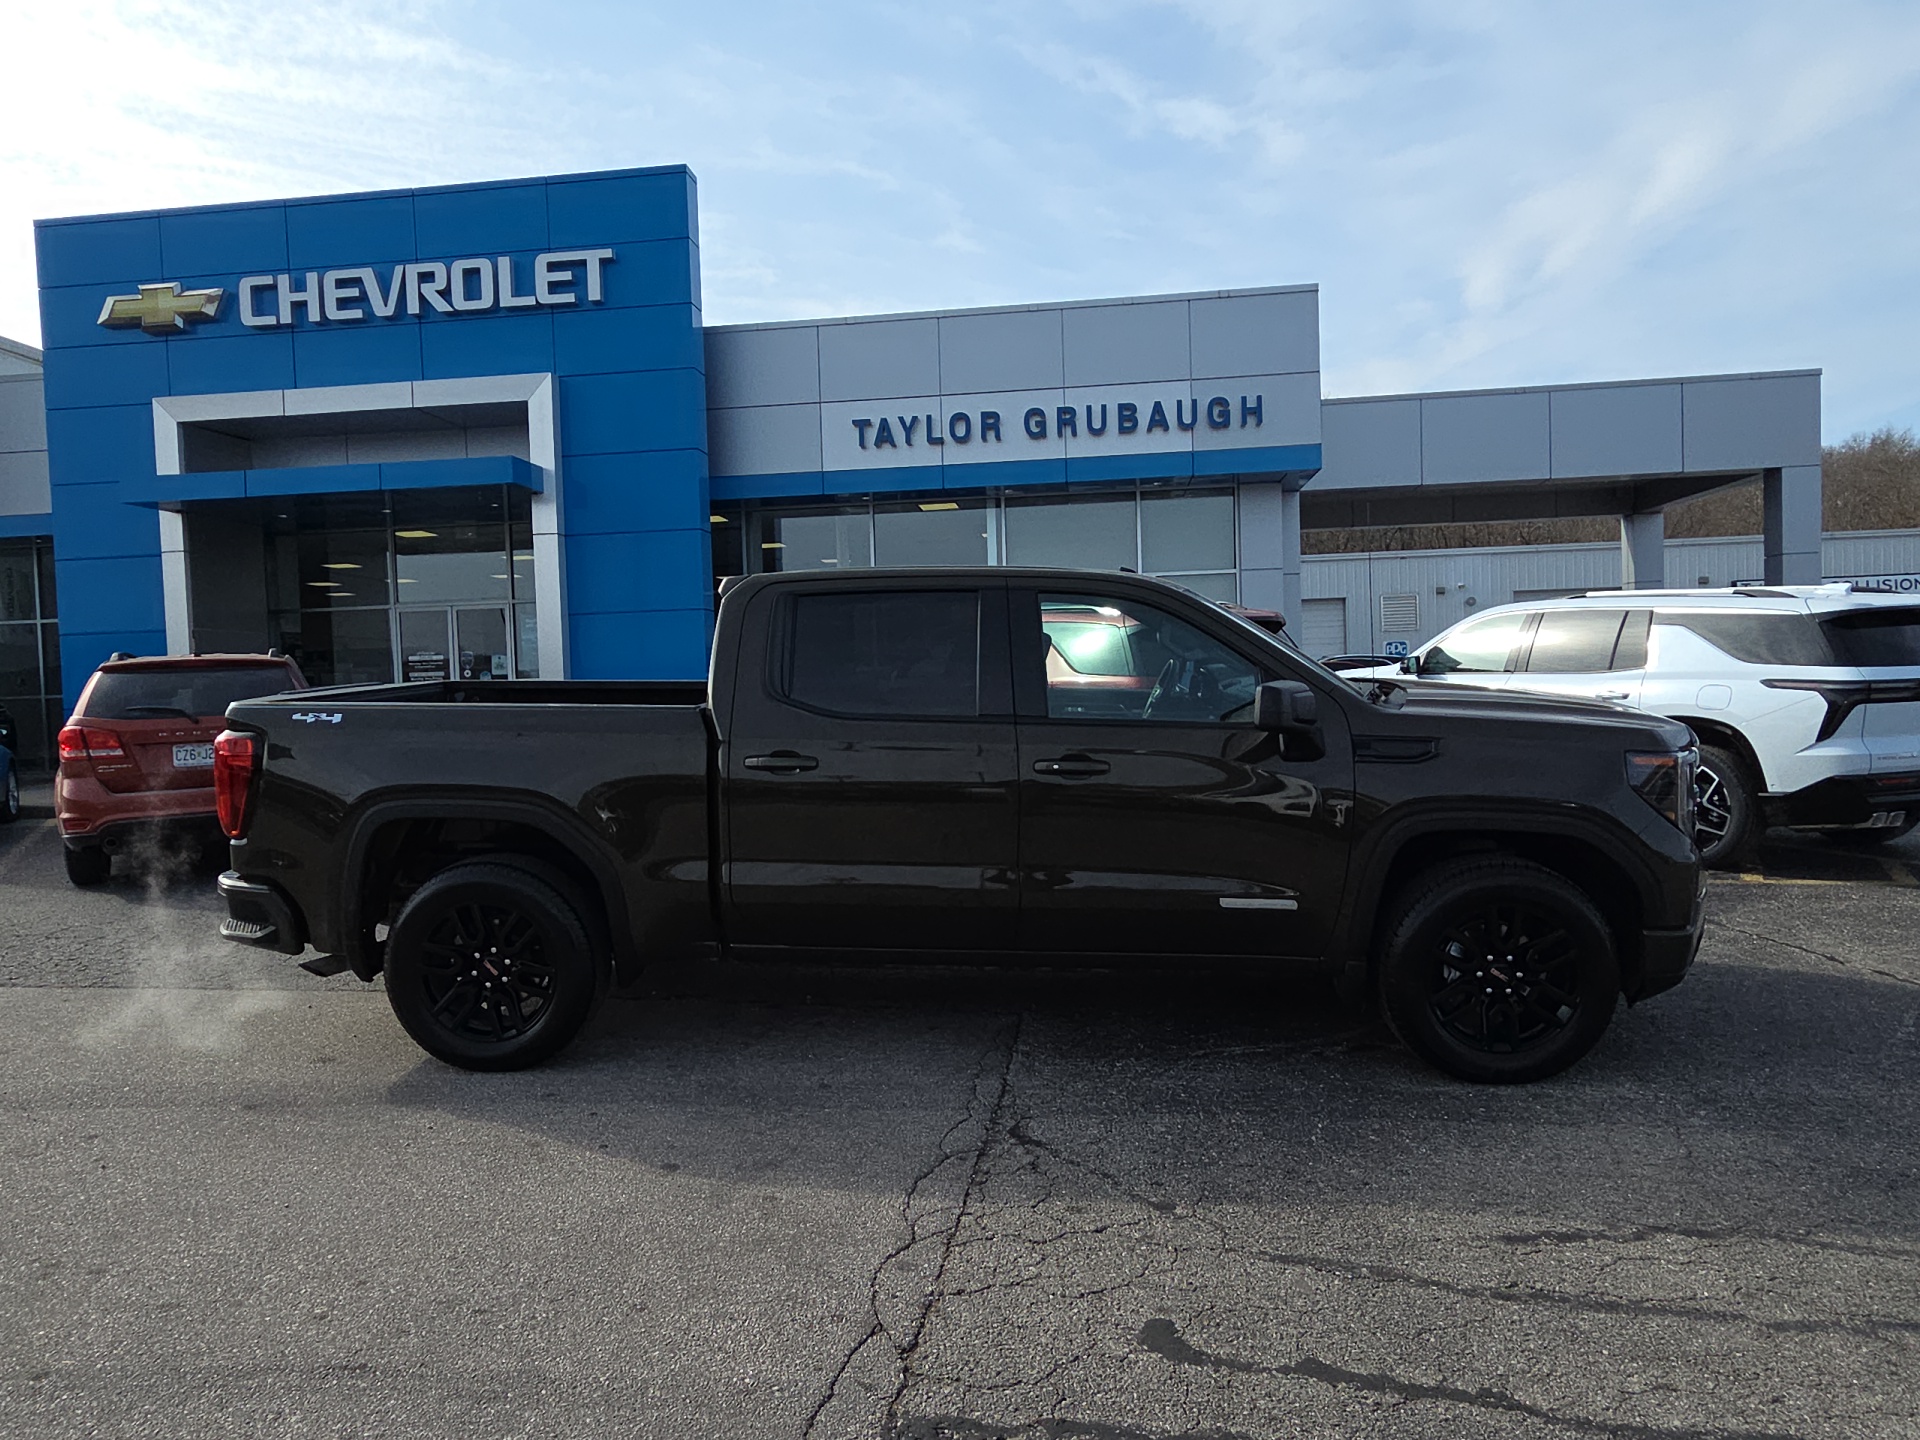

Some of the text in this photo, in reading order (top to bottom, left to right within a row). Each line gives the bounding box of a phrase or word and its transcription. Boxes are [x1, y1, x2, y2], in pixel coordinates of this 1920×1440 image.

[238, 248, 614, 326] CHEVROLET
[852, 394, 1264, 449] TAYLOR GRUBAUGH
[175, 747, 215, 761] CZ6 J2
